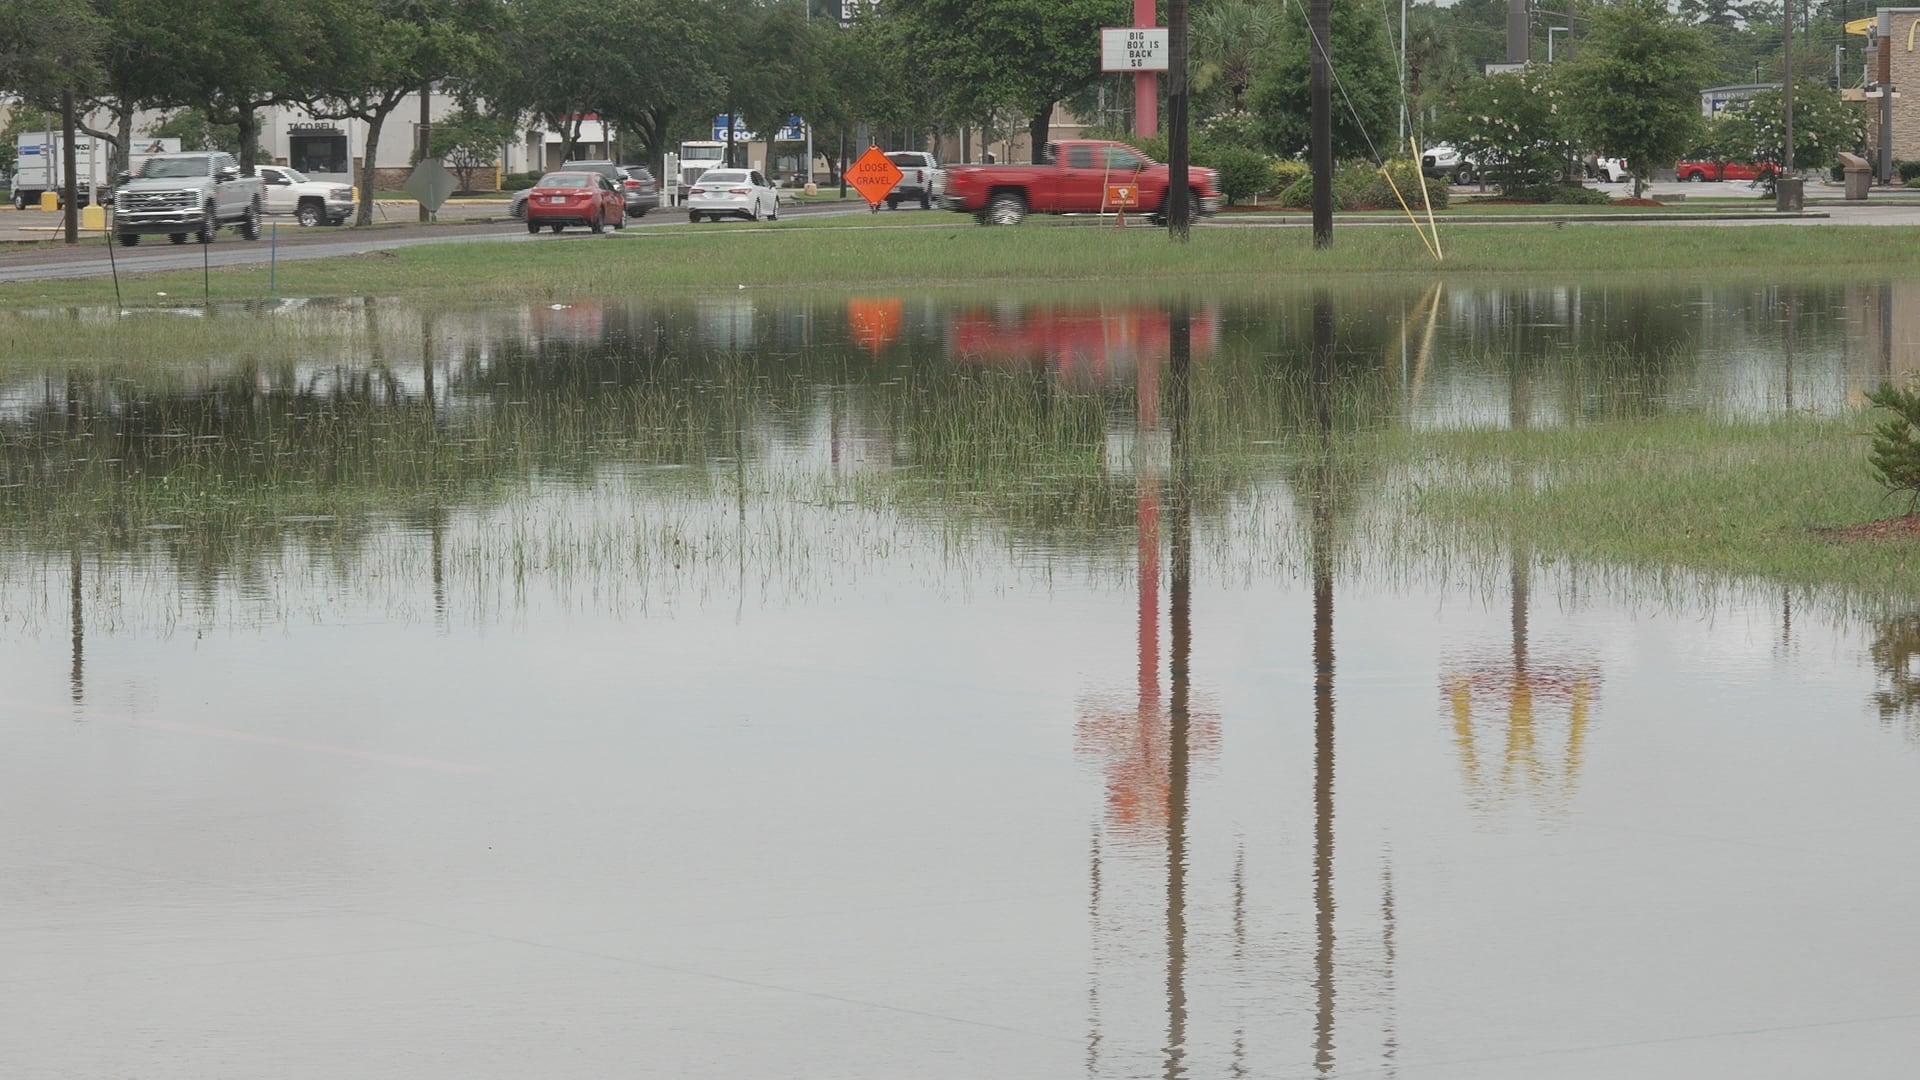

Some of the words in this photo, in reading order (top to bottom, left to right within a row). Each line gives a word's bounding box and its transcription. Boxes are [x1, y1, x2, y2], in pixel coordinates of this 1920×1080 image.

[1129, 32, 1144, 40] BIG
[1127, 41, 1145, 49] BOX
[1150, 41, 1160, 49] IS
[1129, 50, 1153, 58] BACK
[859, 163, 889, 172] LOOSE
[856, 176, 892, 185] GRAVEL
